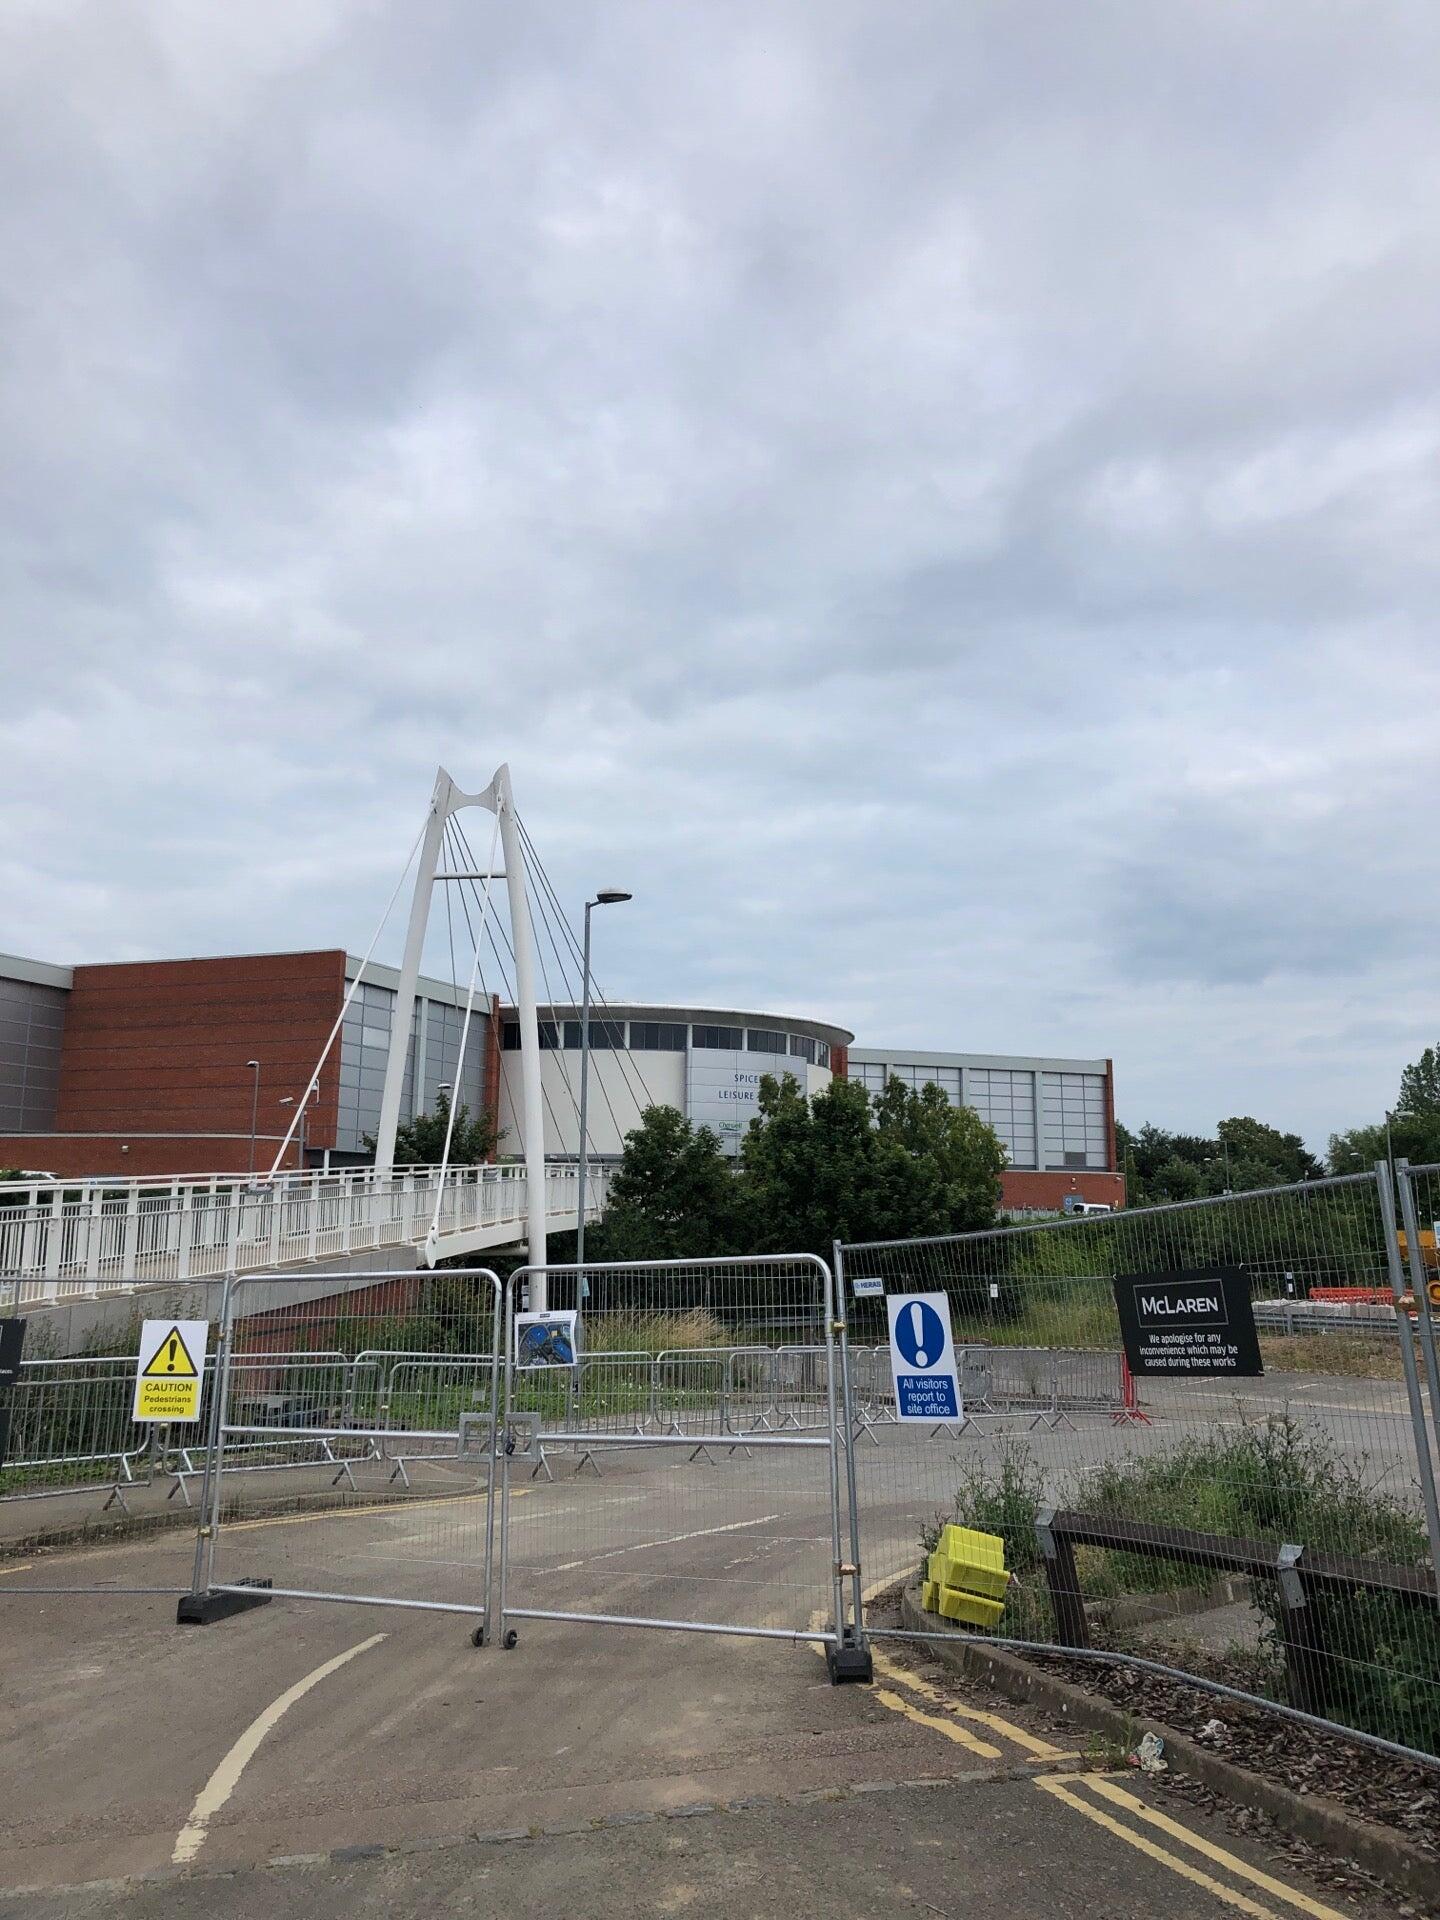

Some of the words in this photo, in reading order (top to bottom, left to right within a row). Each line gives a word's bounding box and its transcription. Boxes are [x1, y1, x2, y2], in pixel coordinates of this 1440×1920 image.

[719, 1090, 754, 1100] LEISURE
[1149, 1334, 1160, 1343] We
[1162, 1333, 1194, 1345] apologise
[1194, 1332, 1205, 1343] for
[1207, 1333, 1221, 1344] any
[1139, 1346, 1186, 1355] inconvenience
[1186, 1345, 1209, 1355] which
[1210, 1345, 1226, 1355] may
[1227, 1344, 1238, 1354] be
[1144, 1357, 1167, 1367] caused
[1168, 1357, 1190, 1368] during
[1191, 1357, 1211, 1367] these
[1212, 1356, 1236, 1367] works
[145, 1383, 193, 1392] CAUTION
[903, 1378, 914, 1389] All
[915, 1378, 948, 1390] visitors
[144, 1395, 191, 1403] Pedestrians
[908, 1391, 934, 1403] report
[936, 1391, 946, 1402] to
[149, 1406, 185, 1414] crossing
[907, 1403, 923, 1414] site
[925, 1403, 950, 1414] office
